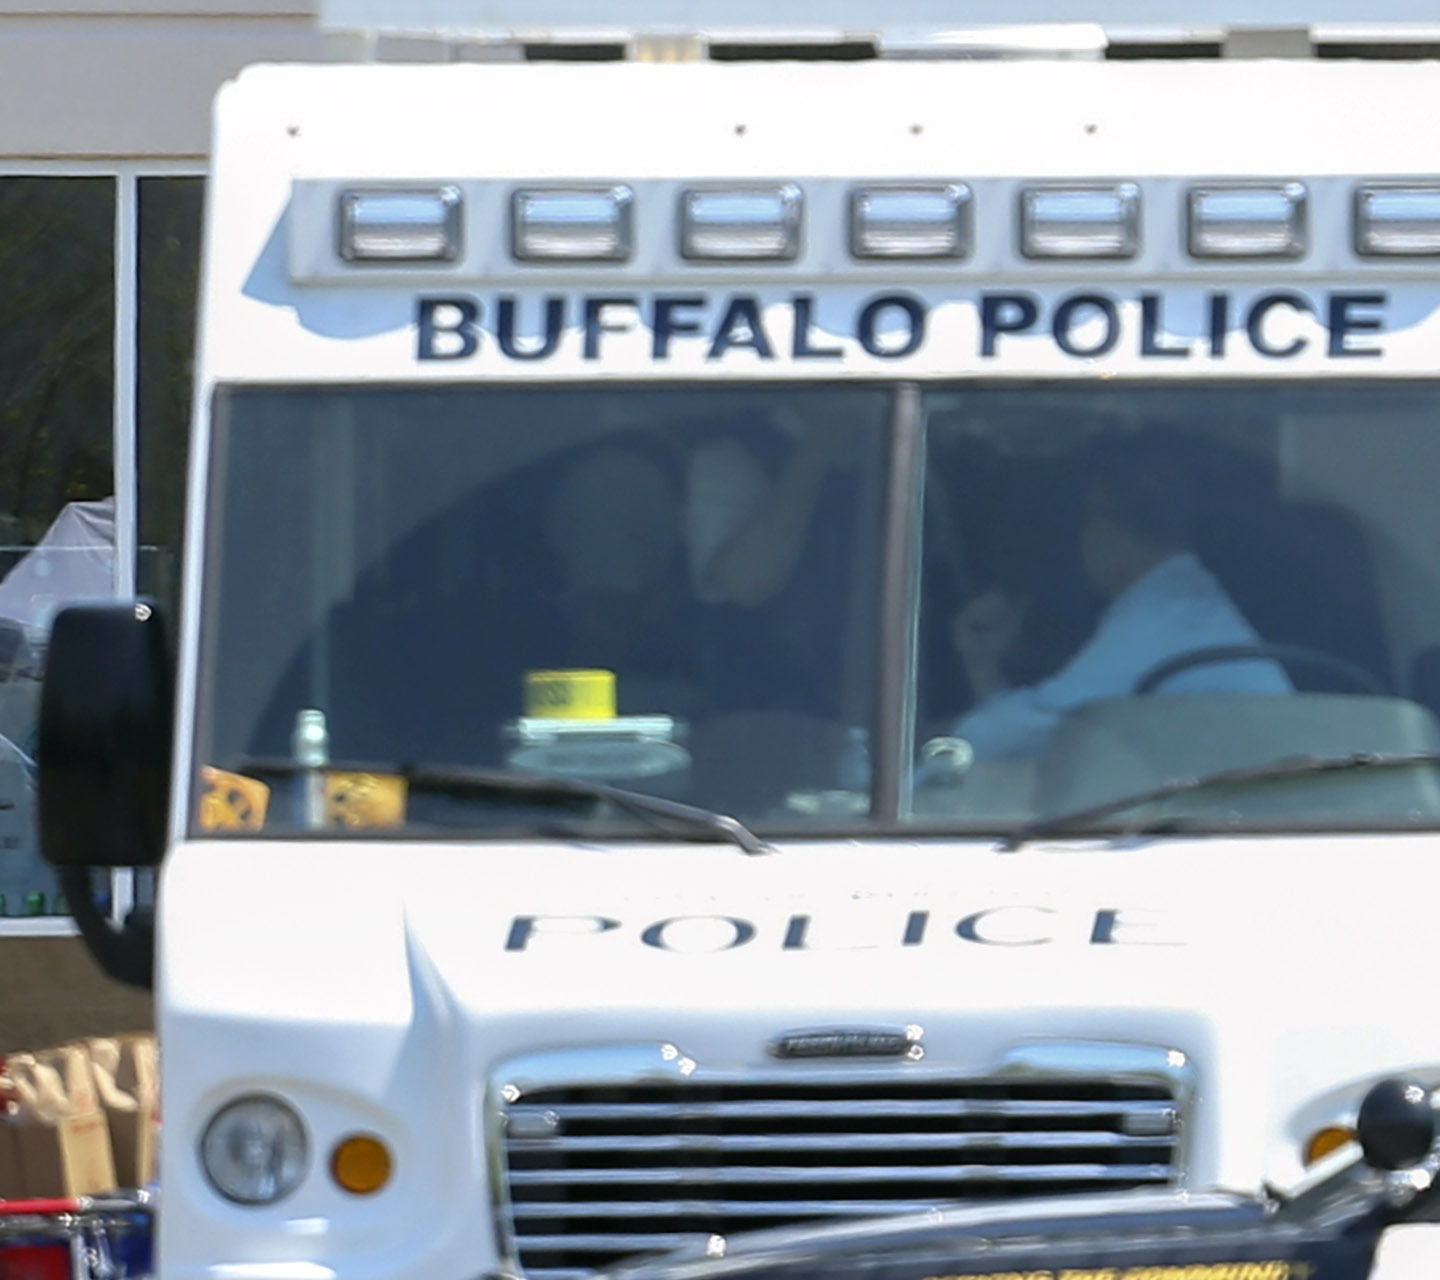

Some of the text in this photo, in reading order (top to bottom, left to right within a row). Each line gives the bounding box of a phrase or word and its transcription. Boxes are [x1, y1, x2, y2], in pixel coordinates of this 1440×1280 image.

[414, 287, 1389, 362] BUFFALO POLICE
[504, 906, 1188, 954] POLICE
